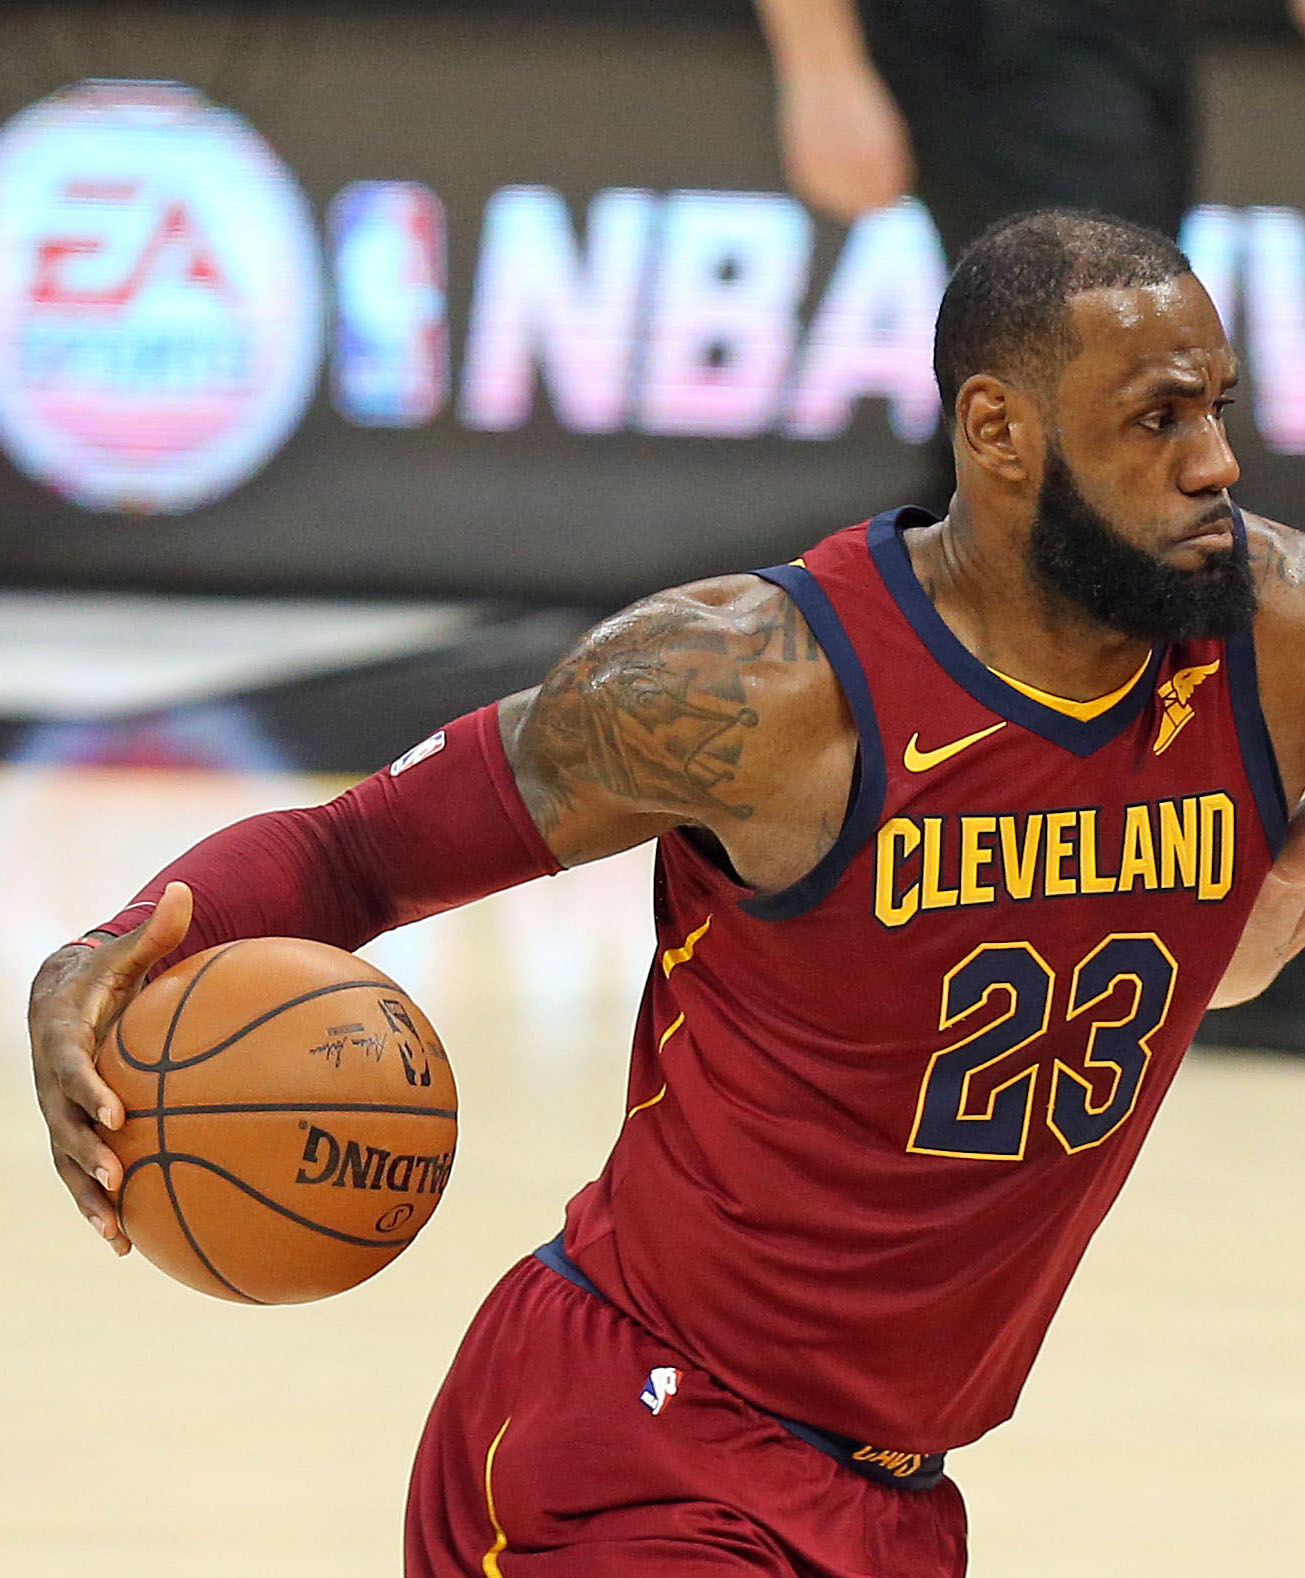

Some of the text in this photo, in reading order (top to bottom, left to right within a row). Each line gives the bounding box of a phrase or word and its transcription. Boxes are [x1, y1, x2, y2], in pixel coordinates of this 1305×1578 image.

[456, 184, 948, 444] NBA
[874, 791, 1236, 928] CLEVELAND
[905, 932, 1180, 1161] 23
